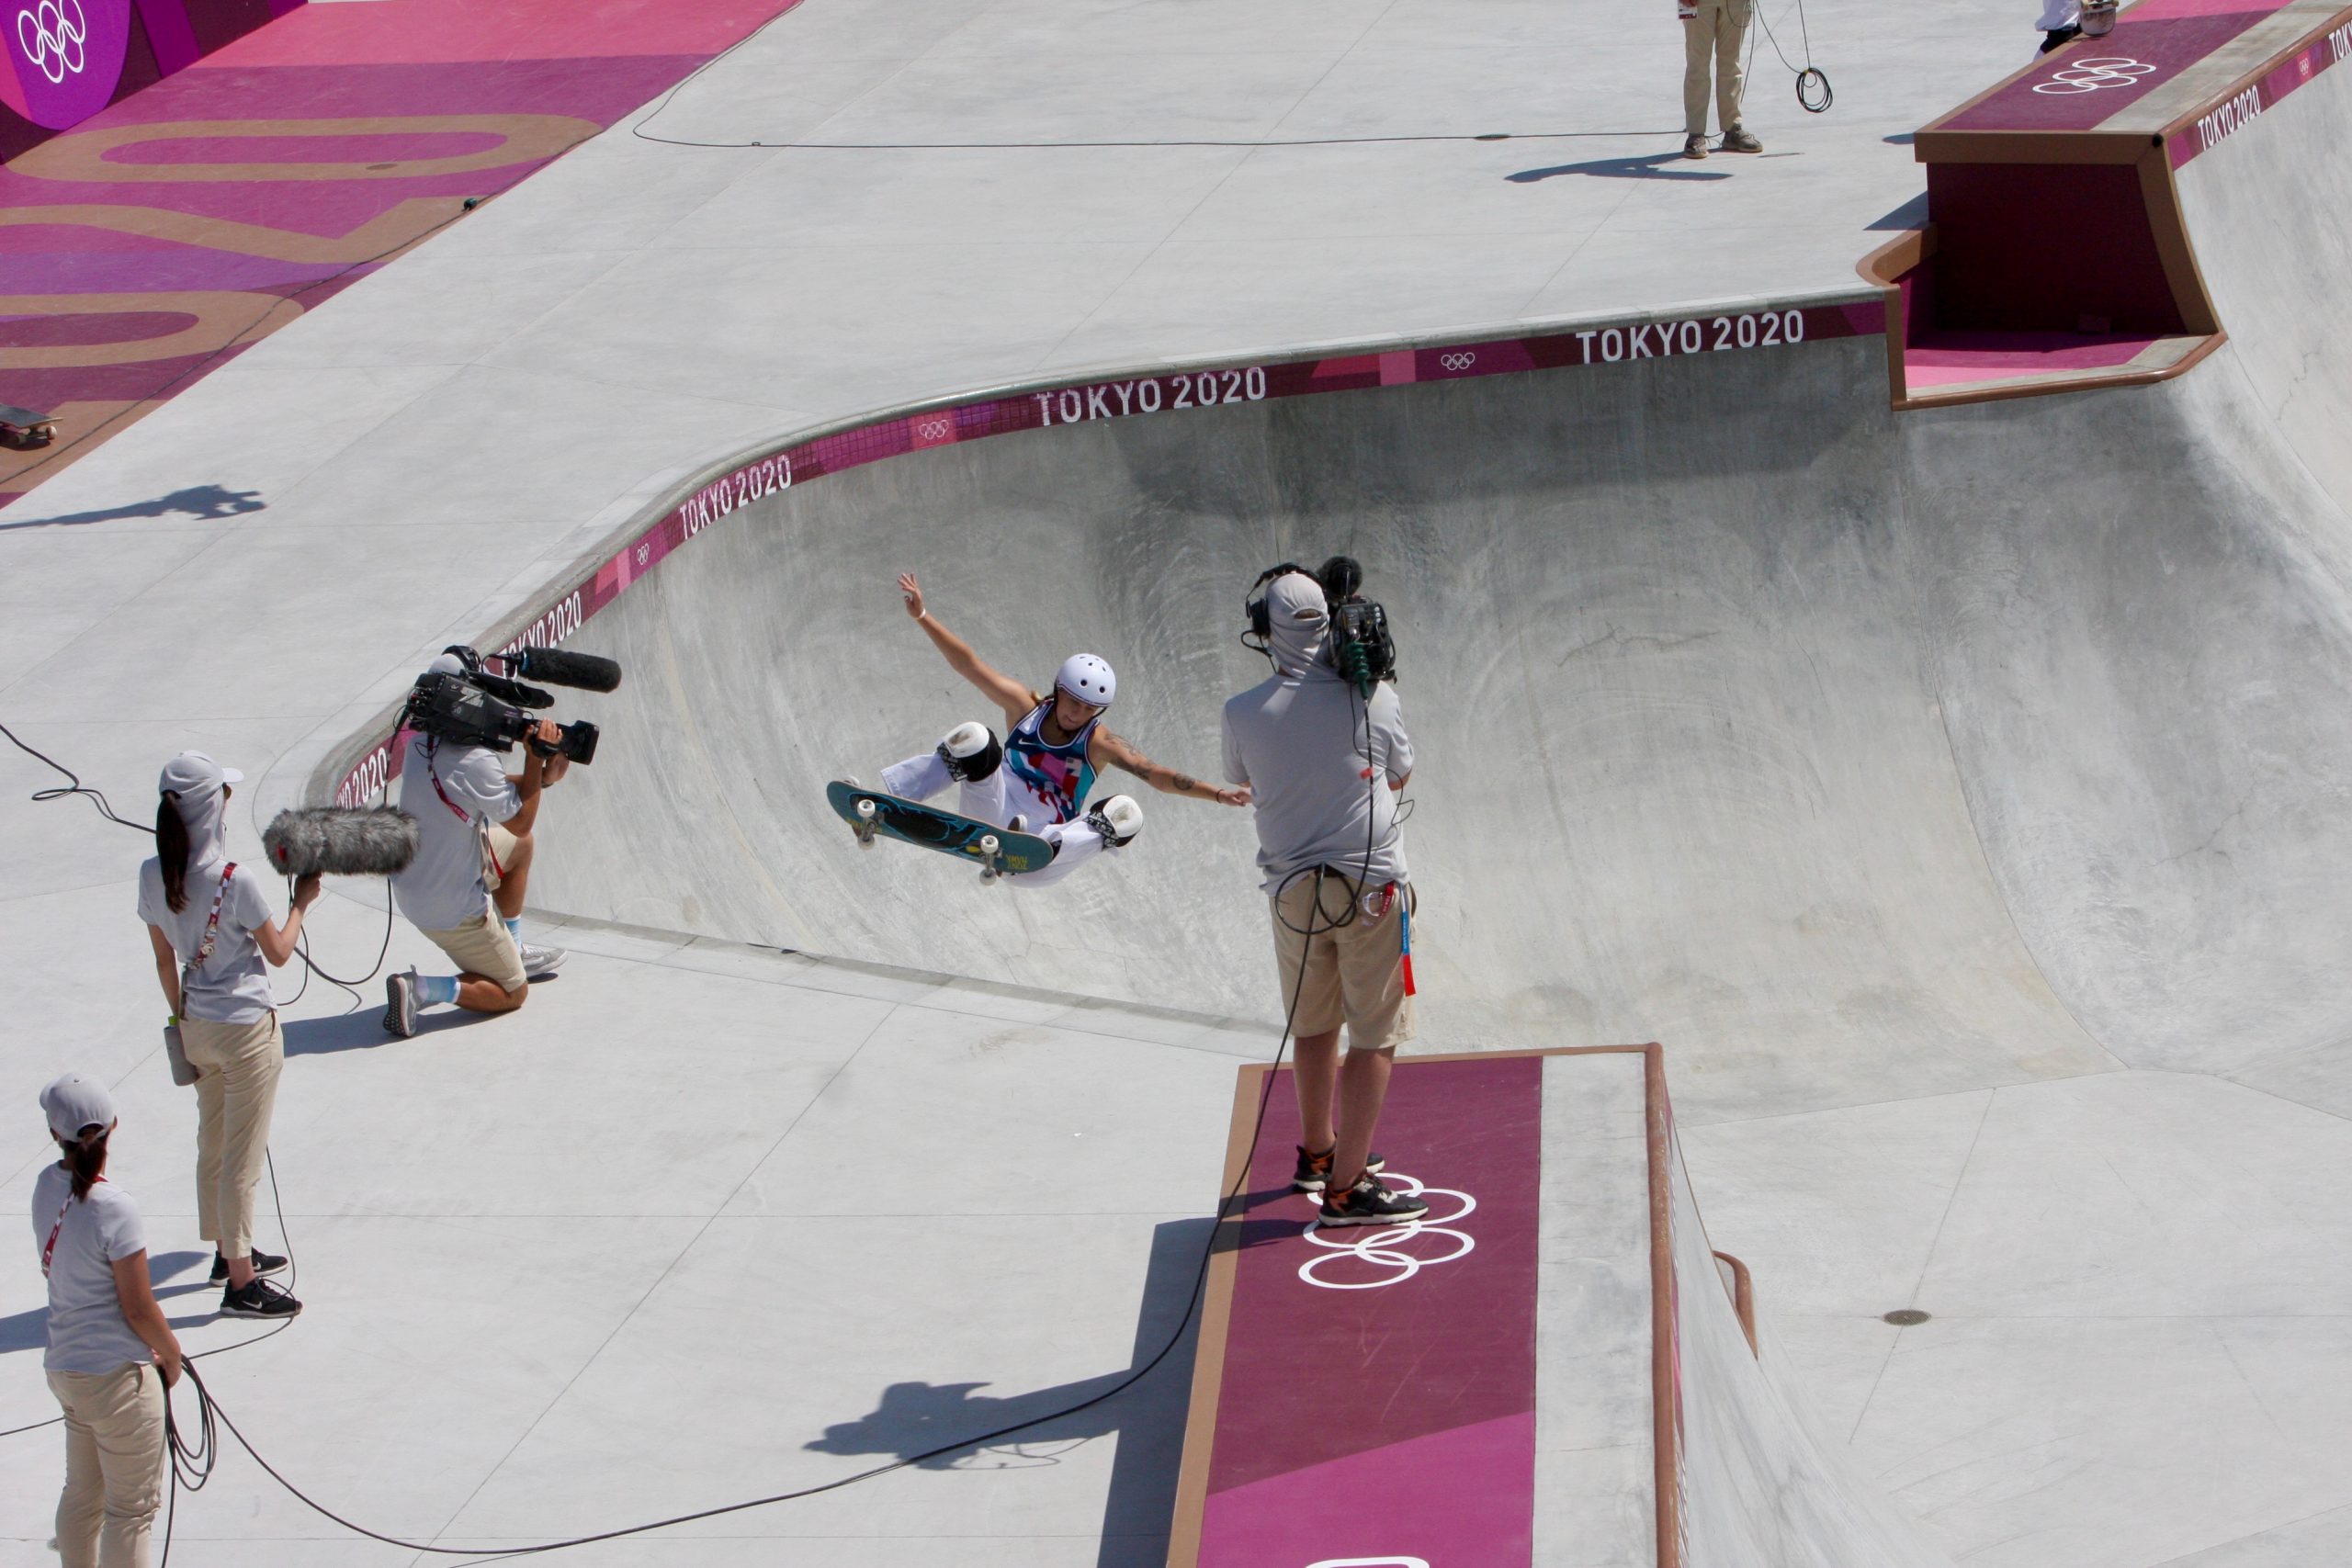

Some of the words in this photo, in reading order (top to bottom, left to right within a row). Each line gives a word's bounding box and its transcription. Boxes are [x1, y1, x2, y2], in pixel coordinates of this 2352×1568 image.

[2198, 102, 2234, 151] TOKYO
[2233, 85, 2260, 130] 2020
[1576, 321, 1702, 365] TOKYO
[1713, 310, 1804, 351] 2020
[1035, 378, 1161, 426] TOKYO
[1171, 367, 1266, 409] 2020
[680, 479, 732, 540] TOKYO
[735, 454, 791, 508] 2020
[548, 590, 581, 649] 2020
[352, 747, 387, 807] 2020
